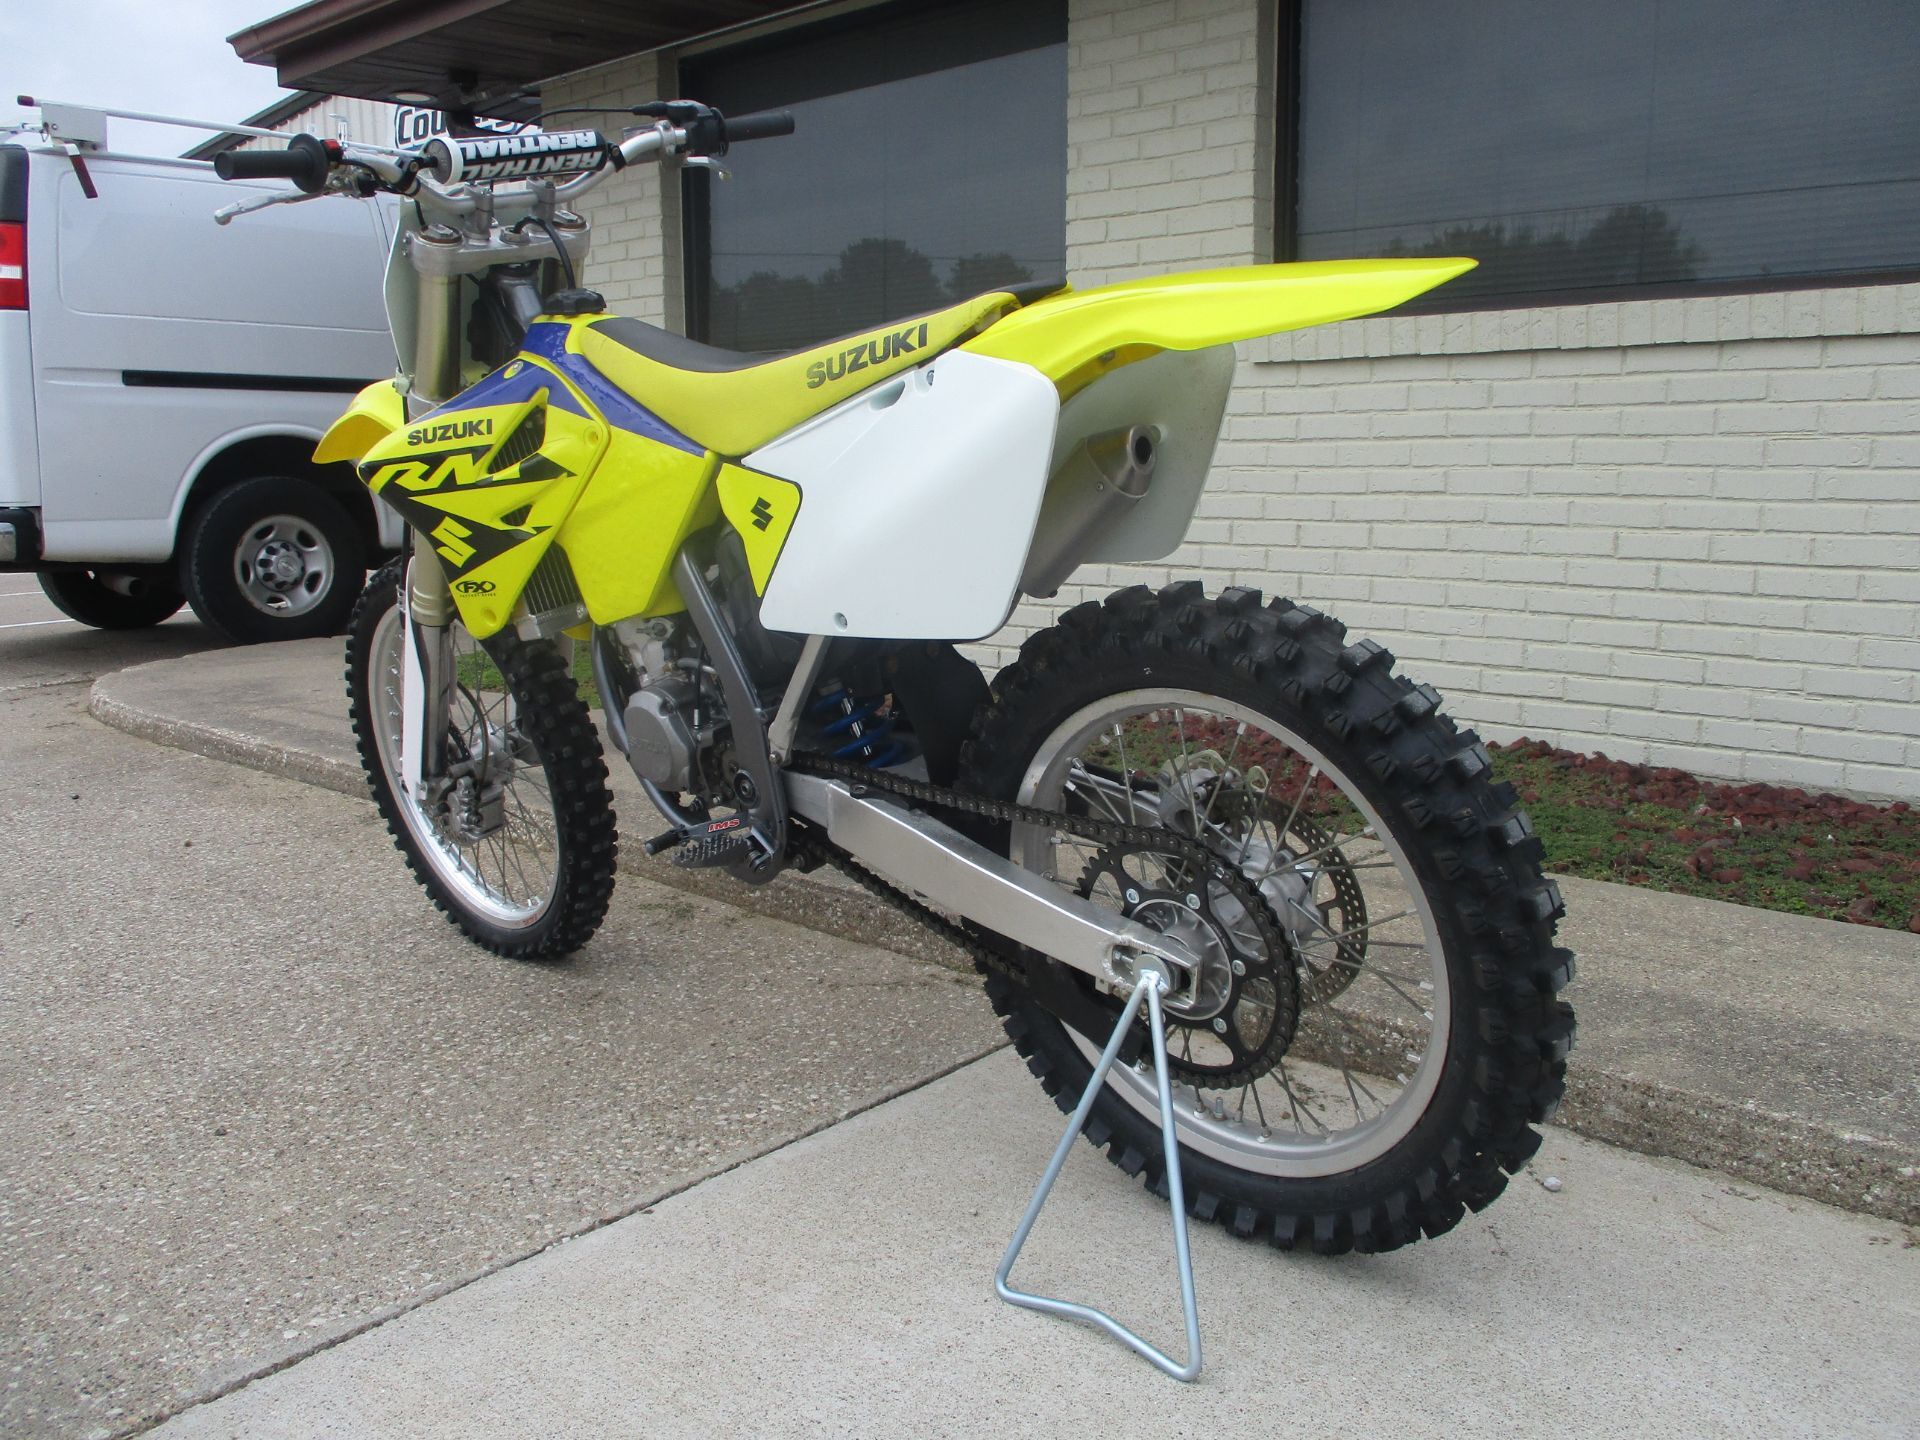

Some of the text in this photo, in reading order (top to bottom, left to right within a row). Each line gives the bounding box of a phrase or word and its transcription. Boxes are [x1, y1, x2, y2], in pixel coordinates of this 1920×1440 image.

[460, 131, 597, 160] RENTHAL
[463, 150, 603, 180] RENTHAL
[806, 322, 928, 389] SUZUKI
[407, 418, 493, 446] SUZUKI
[708, 818, 740, 832] IMS
